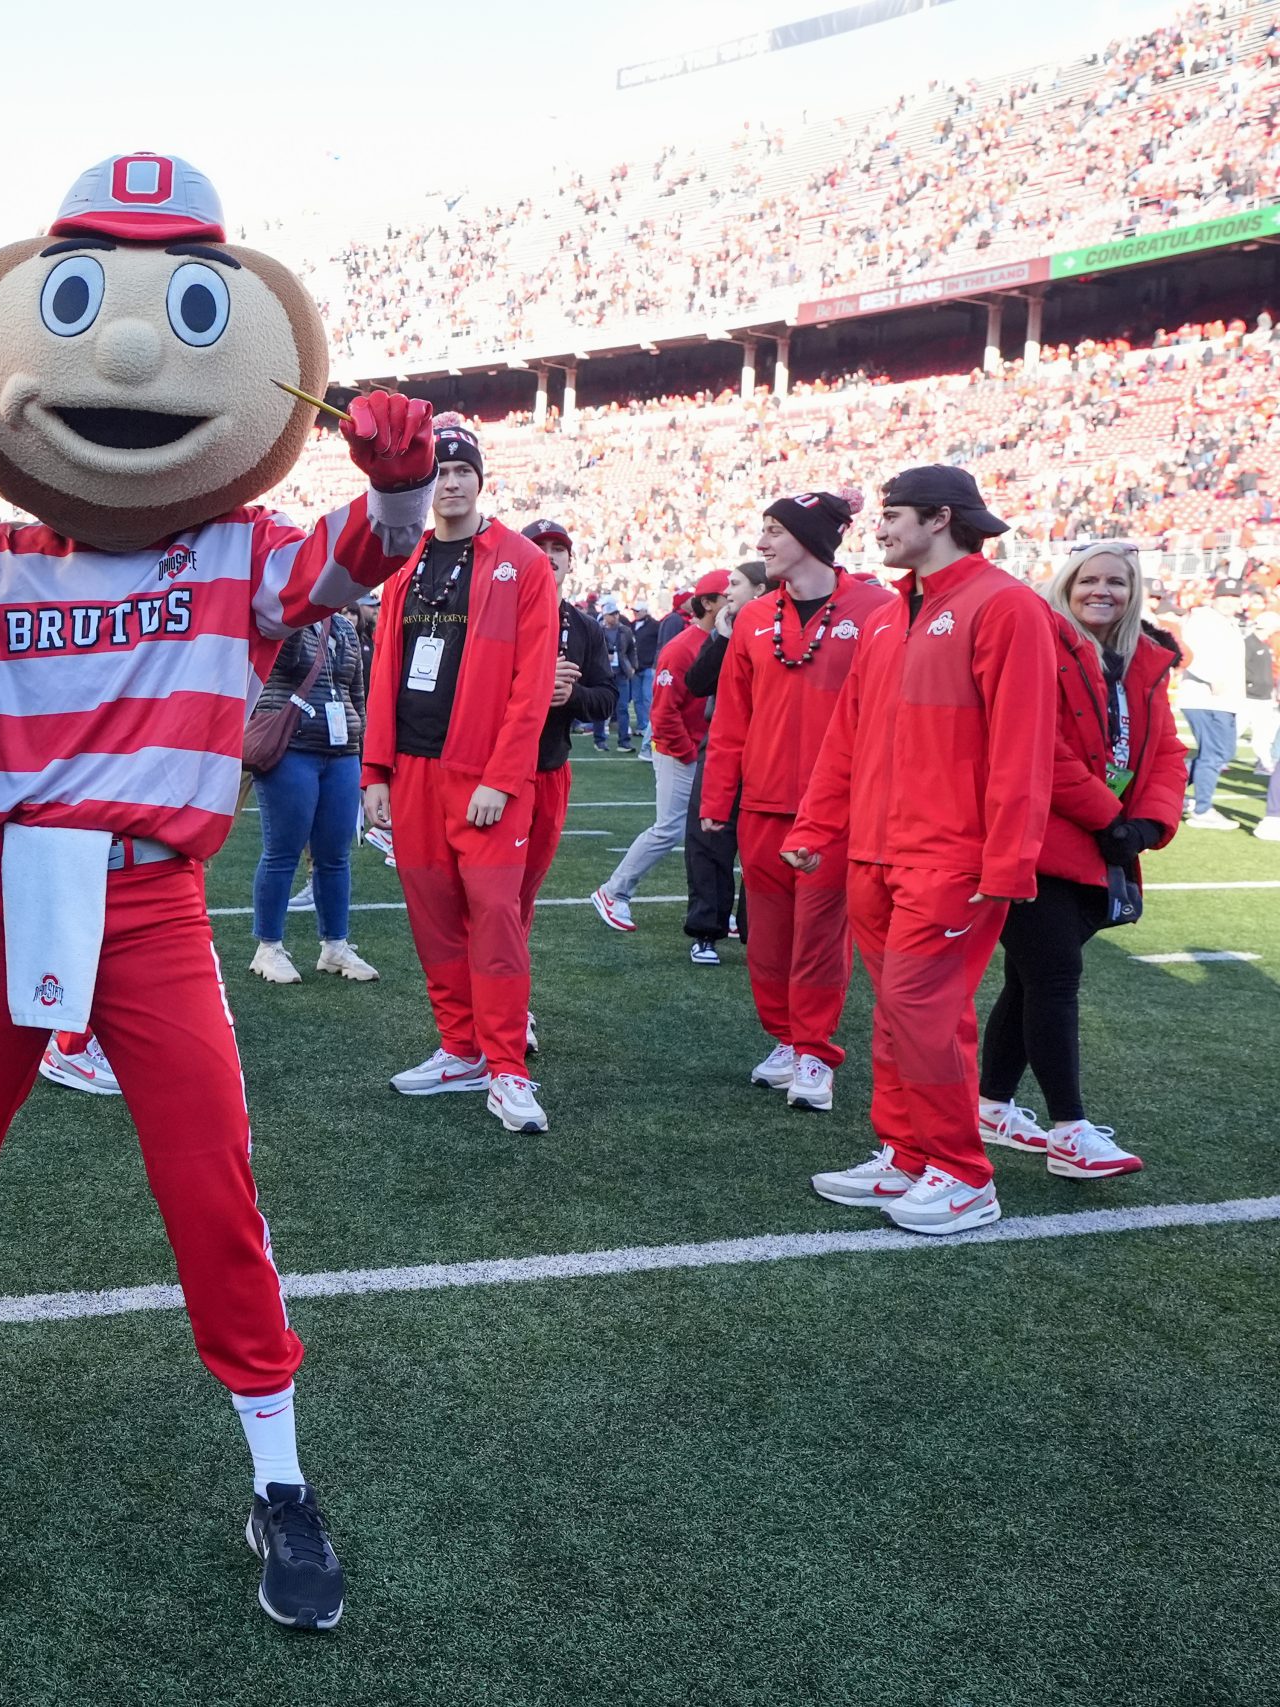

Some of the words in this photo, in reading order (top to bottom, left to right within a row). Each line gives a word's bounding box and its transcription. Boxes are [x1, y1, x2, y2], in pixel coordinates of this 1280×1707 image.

[111, 156, 175, 205] O
[1085, 215, 1263, 266] CONGRATULATIONS
[859, 290, 899, 311] BEST
[899, 281, 943, 303] FANS
[947, 281, 959, 291] IN
[962, 275, 986, 290] THE
[990, 268, 1025, 283] LAND
[5, 588, 193, 654] BRUTUS
[402, 613, 430, 625] REVER
[433, 613, 468, 624] UCKEYE
